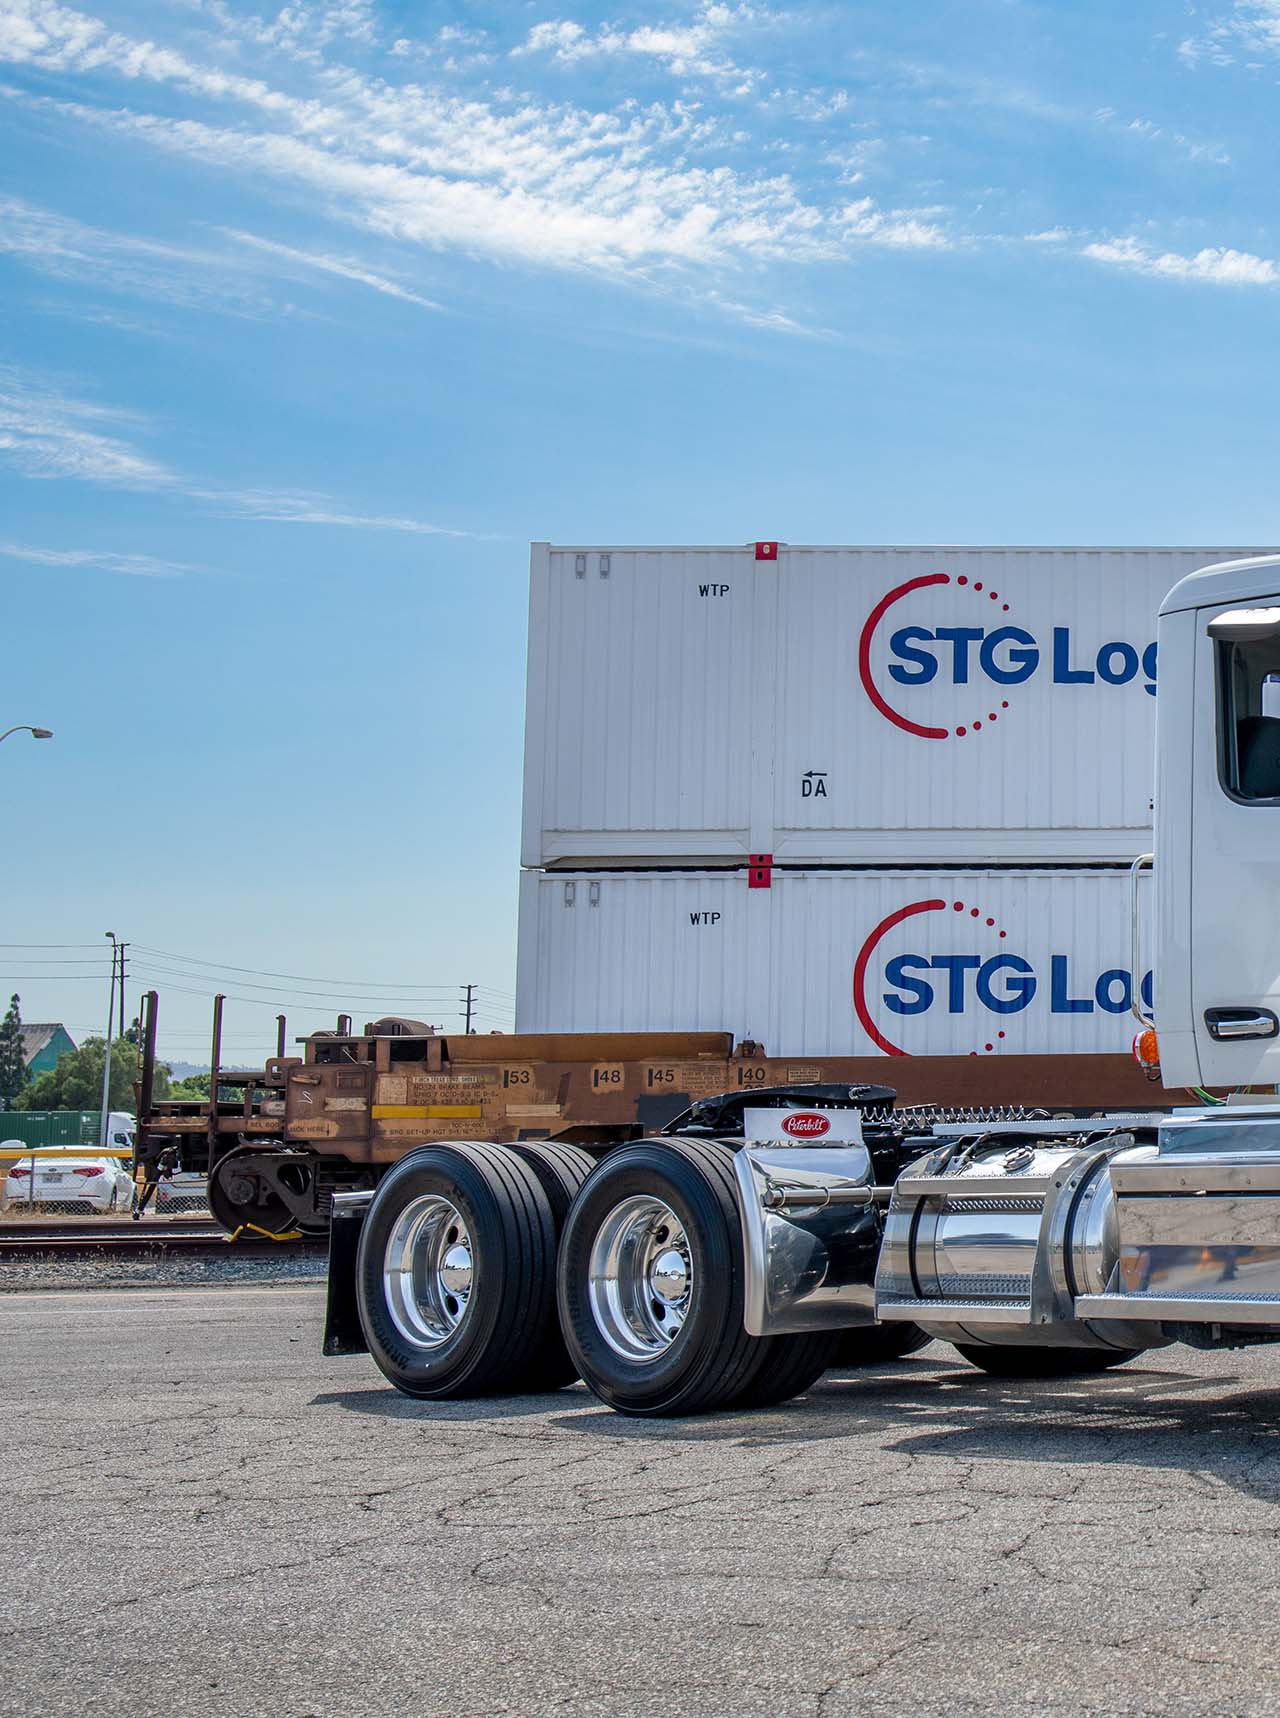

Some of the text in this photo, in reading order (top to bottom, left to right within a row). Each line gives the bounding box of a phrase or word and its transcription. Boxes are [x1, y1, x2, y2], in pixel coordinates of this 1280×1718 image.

[698, 583, 730, 597] WTP
[887, 625, 1040, 686] STG
[801, 778, 828, 798] DA
[689, 911, 721, 926] WTP
[882, 953, 1038, 1015] STG
[509, 1070, 530, 1084] 53
[599, 1069, 621, 1083] 48
[653, 1069, 675, 1083] 45
[743, 1067, 766, 1081] 40
[787, 1117, 827, 1133] Peterbilt
